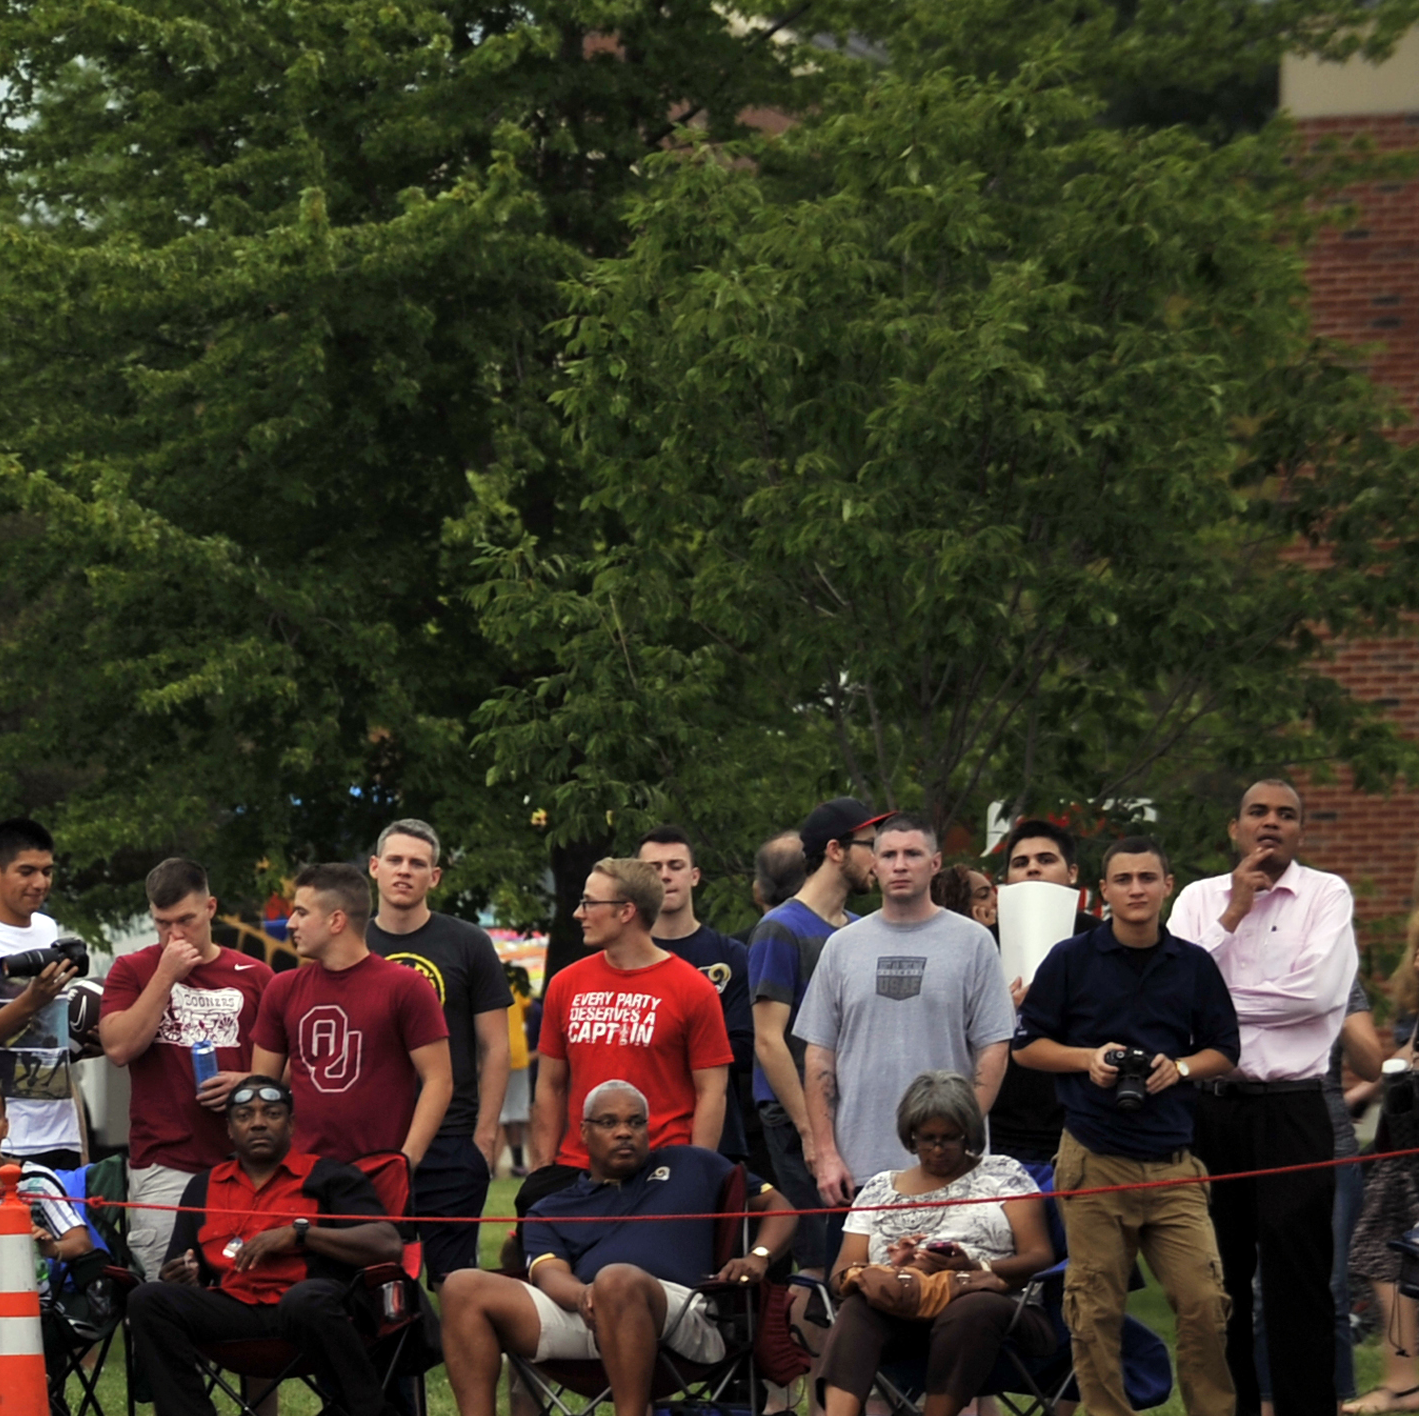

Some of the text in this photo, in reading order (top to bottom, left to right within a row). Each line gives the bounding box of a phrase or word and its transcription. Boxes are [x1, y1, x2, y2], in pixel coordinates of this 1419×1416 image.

[571, 991, 662, 1011] EVERY PARTY
[569, 1006, 656, 1026] DESERVES A
[298, 1005, 362, 1093] OU
